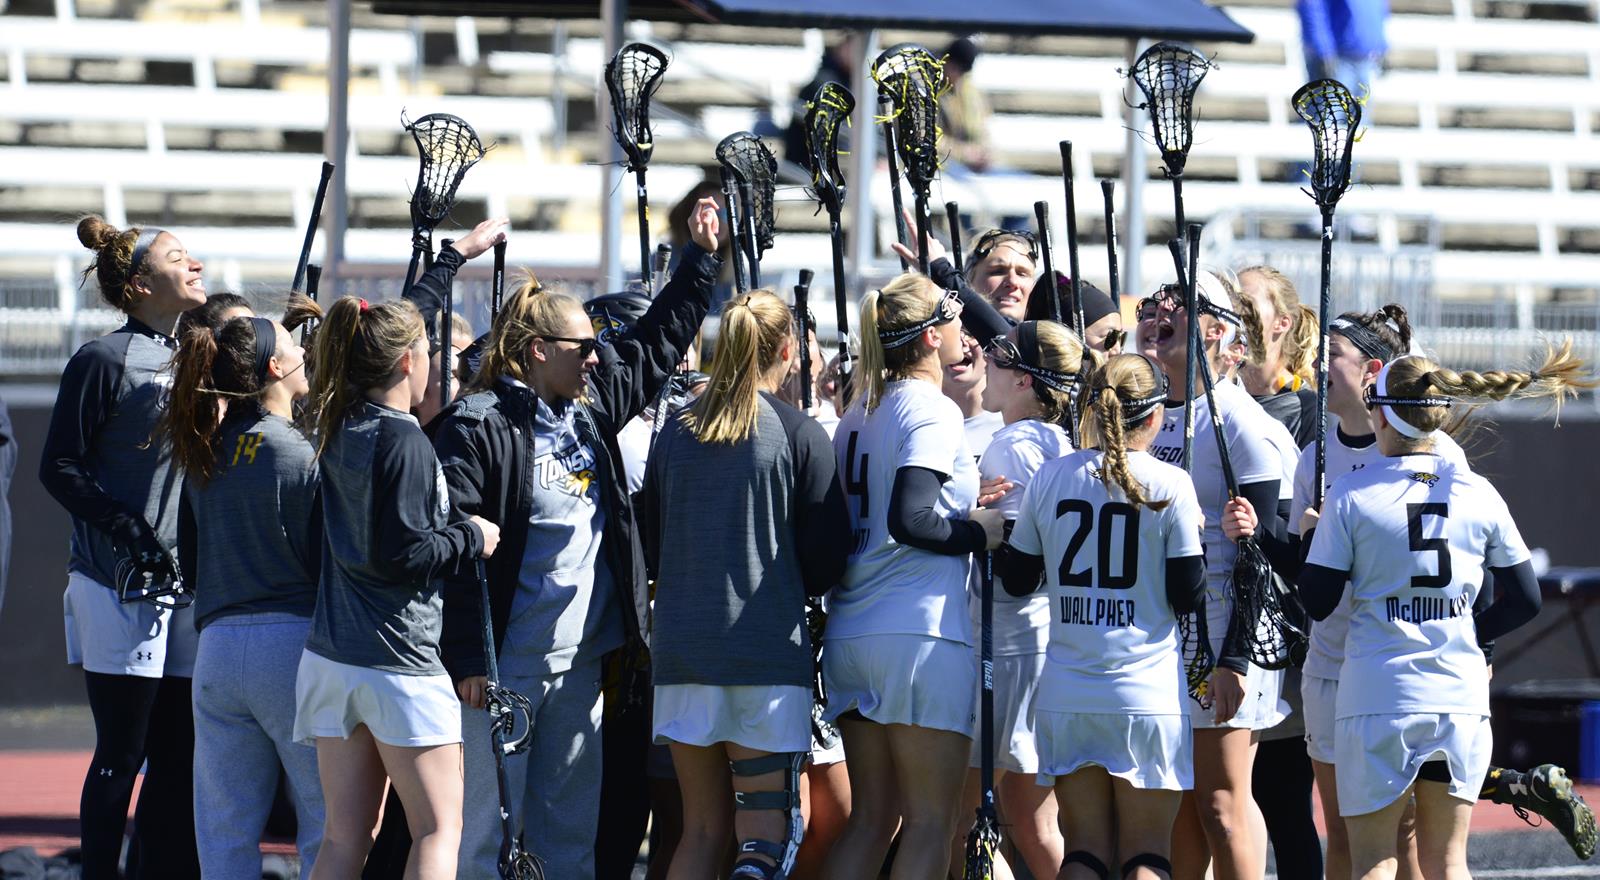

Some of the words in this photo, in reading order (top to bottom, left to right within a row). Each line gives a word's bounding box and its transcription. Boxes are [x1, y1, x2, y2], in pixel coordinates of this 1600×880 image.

[232, 432, 264, 466] 14
[845, 430, 870, 518] 4
[1056, 498, 1141, 589] 20
[1406, 502, 1453, 588] 5
[1060, 596, 1135, 627] WALLPHER
